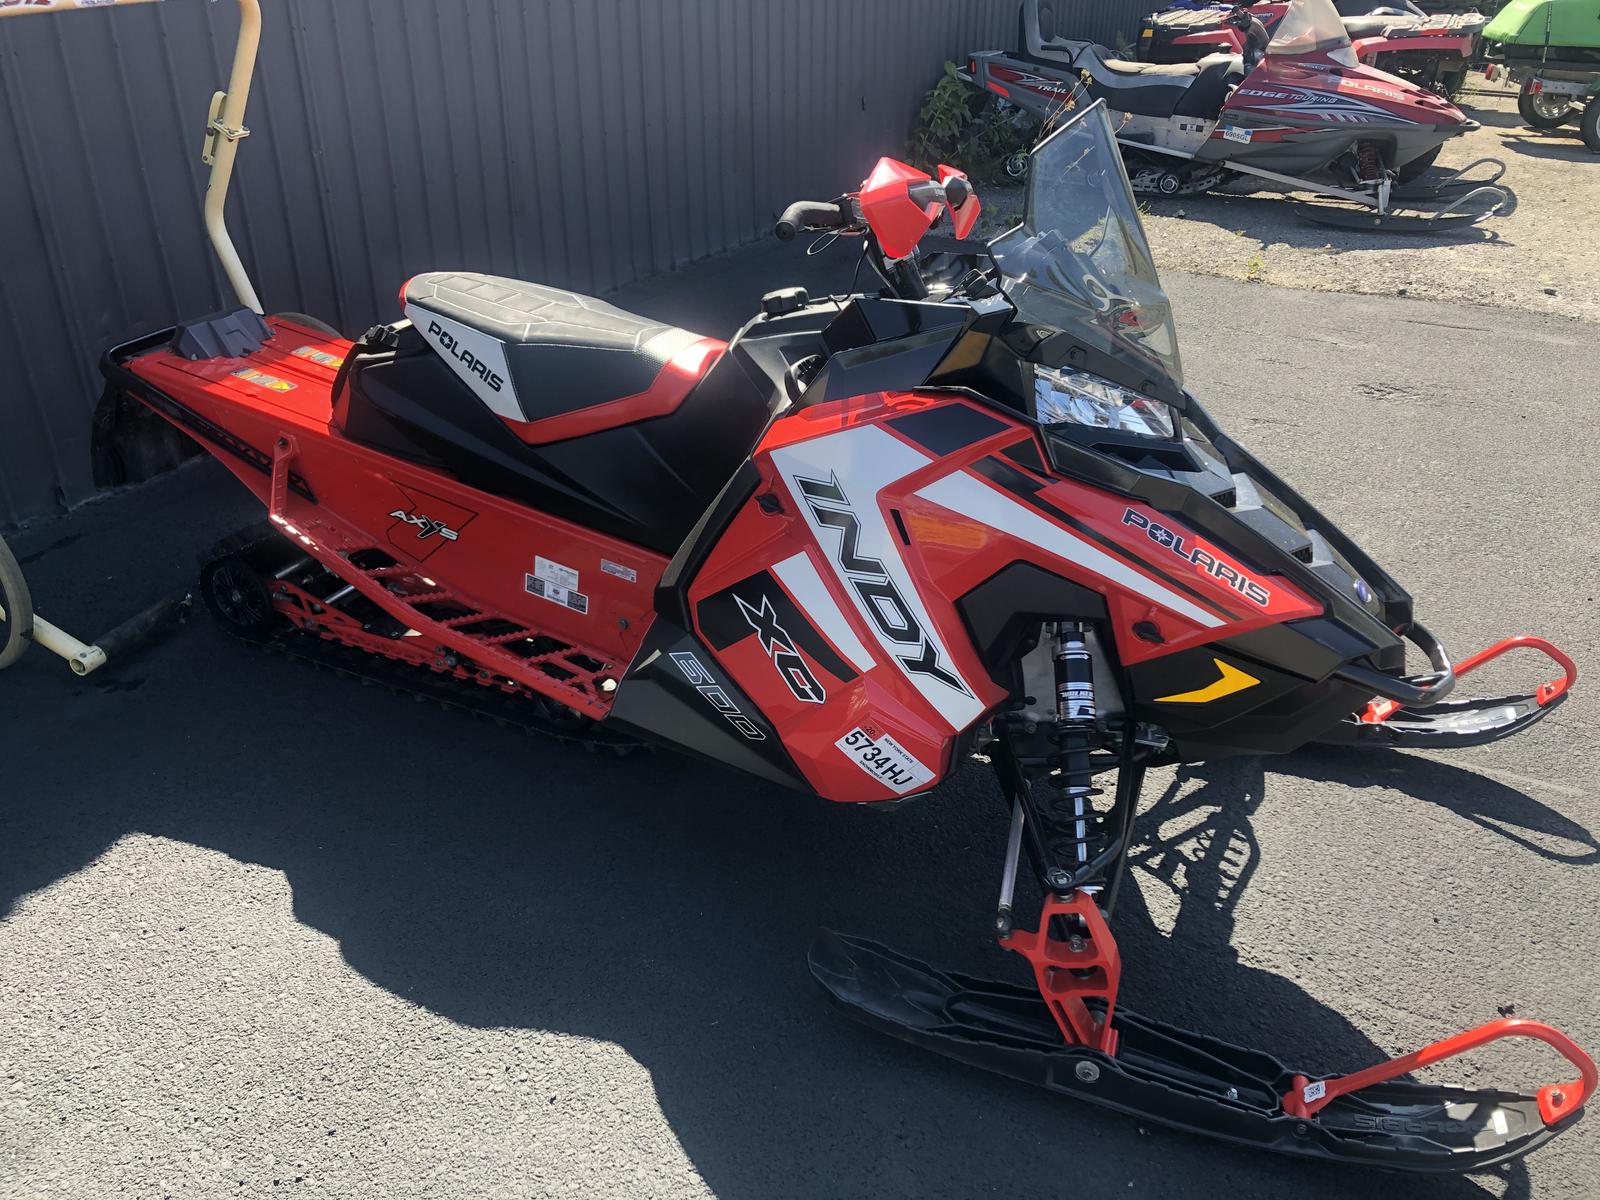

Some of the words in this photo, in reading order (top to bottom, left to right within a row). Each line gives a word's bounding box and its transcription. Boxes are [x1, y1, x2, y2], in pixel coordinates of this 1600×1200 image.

[1038, 85, 1068, 94] TRAIL
[1237, 88, 1287, 99] EDGE
[1288, 94, 1339, 104] TOURING
[1327, 75, 1405, 100] POLARIS
[428, 320, 504, 392] POLARIS
[389, 510, 459, 541] AXYS
[793, 469, 976, 700] INDY
[1121, 507, 1271, 607] POLARIS
[733, 593, 826, 704] XC
[845, 730, 913, 785] 5734HJ
